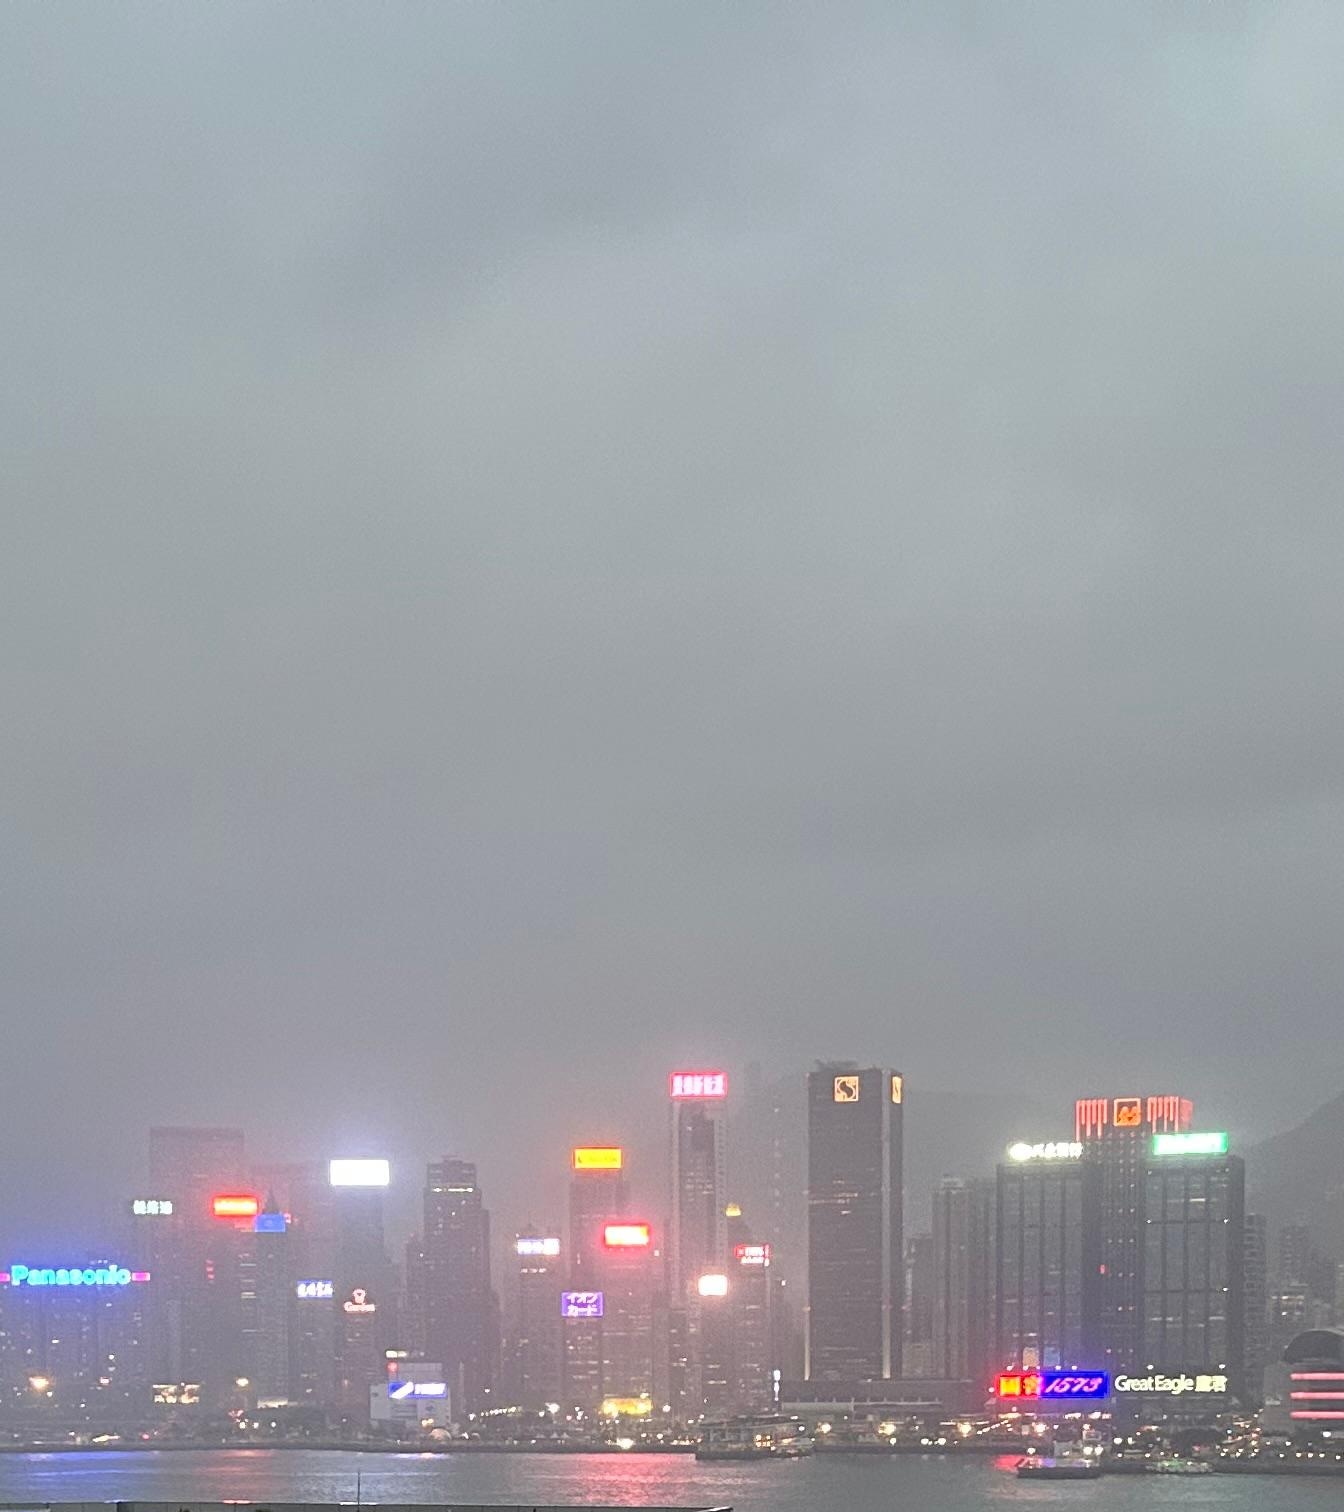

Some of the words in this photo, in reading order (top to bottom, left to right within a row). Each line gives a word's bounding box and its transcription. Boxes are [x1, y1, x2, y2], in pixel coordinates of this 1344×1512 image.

[11, 1264, 132, 1286] Panasonic
[1044, 1376, 1103, 1394] 1573
[1114, 1374, 1154, 1392] Great
[1154, 1374, 1194, 1395] Eagle
